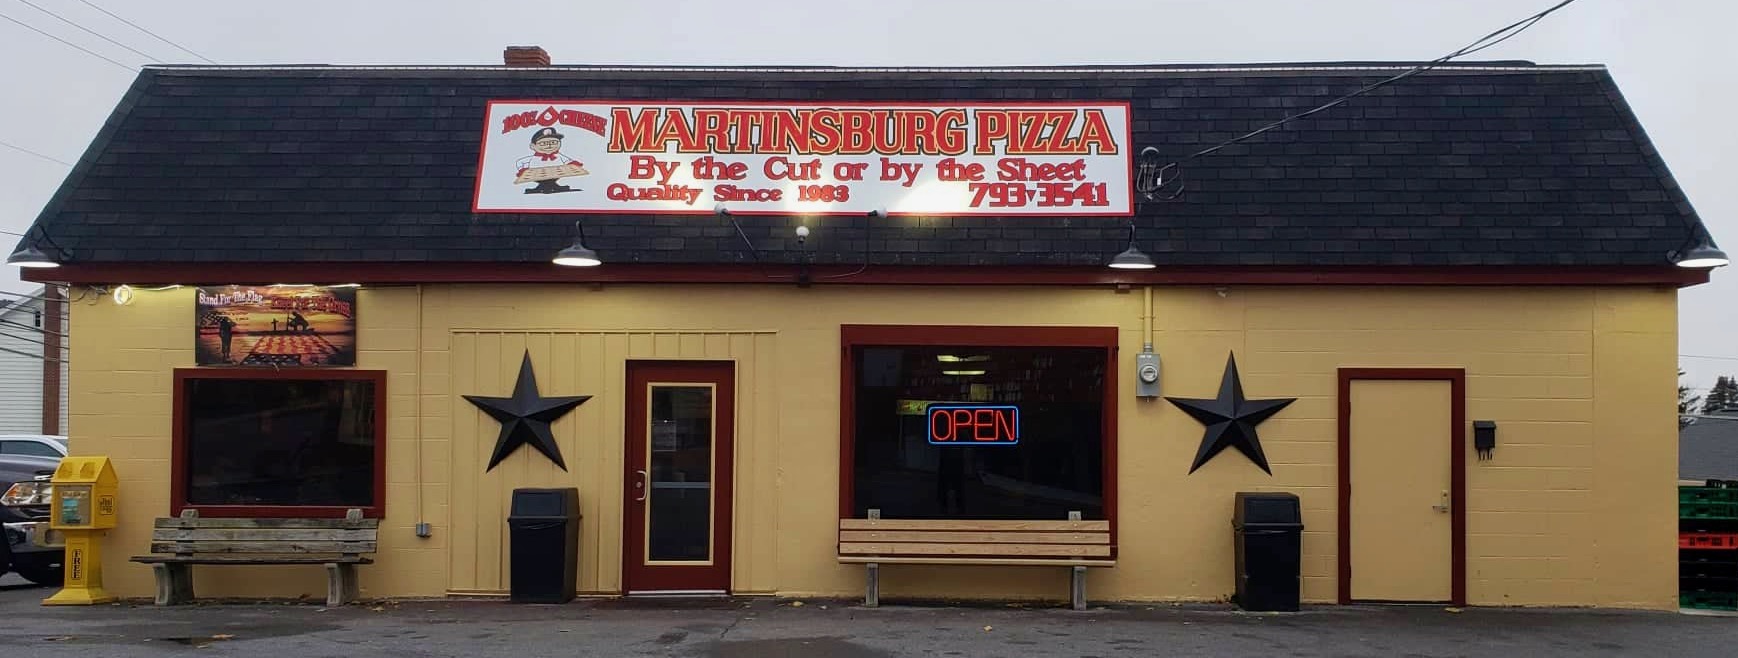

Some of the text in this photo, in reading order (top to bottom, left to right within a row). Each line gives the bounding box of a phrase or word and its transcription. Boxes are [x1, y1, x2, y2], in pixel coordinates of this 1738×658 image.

[559, 109, 607, 137] CHEESE
[607, 107, 1118, 155] MARTINSBURG PIZZA
[628, 155, 1087, 187] By the Cut or by the Sheet
[606, 183, 850, 205] Quality Since 1983
[199, 291, 218, 305] Stand
[931, 409, 1016, 442] OPEN
[73, 549, 81, 579] FREE
